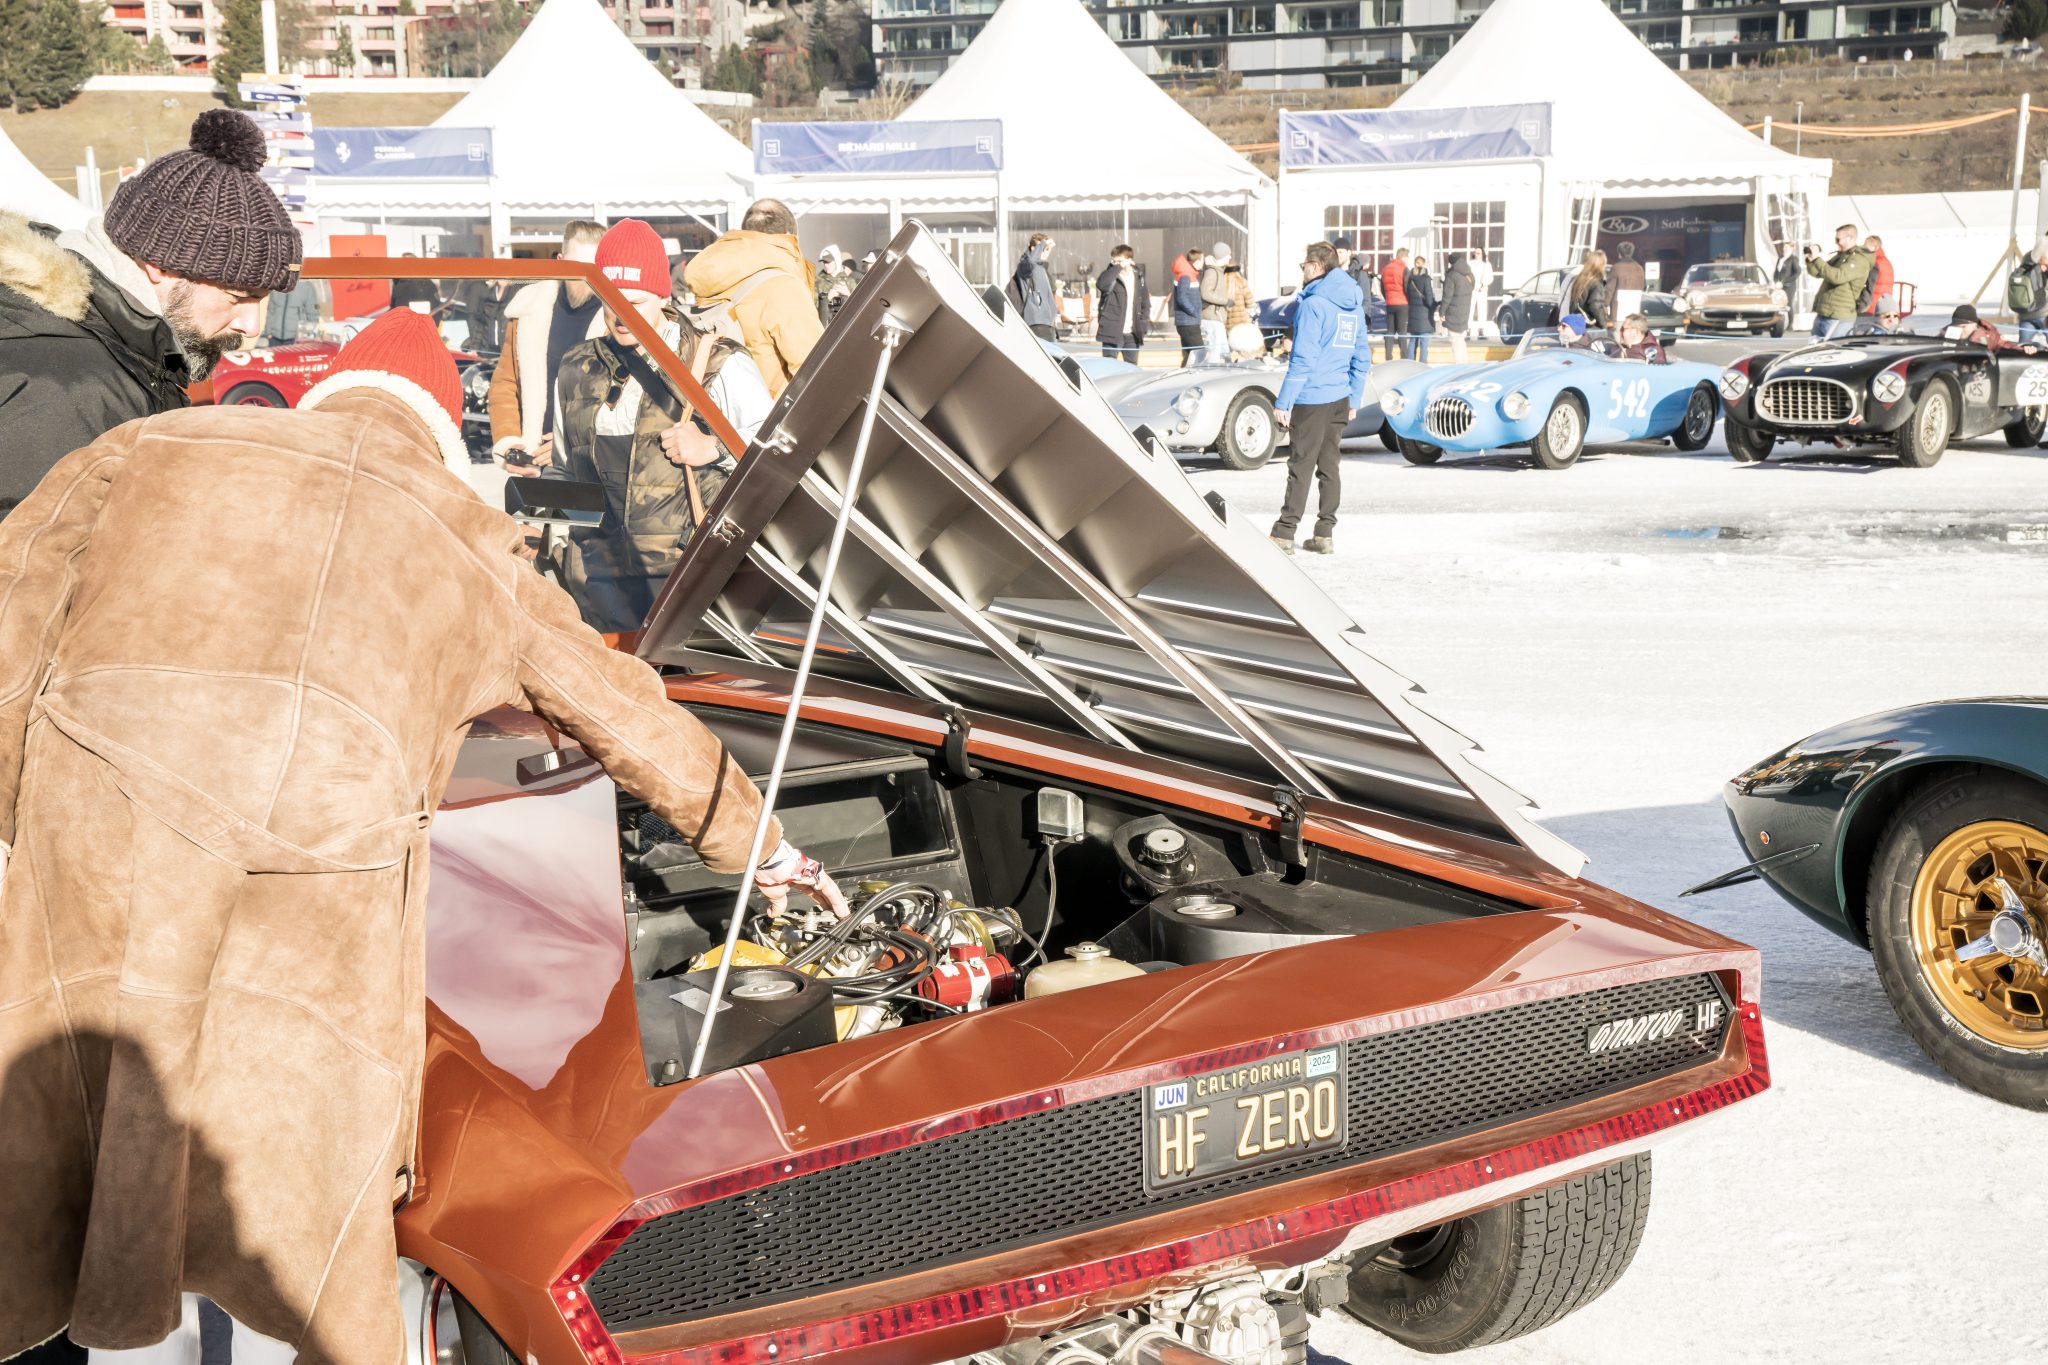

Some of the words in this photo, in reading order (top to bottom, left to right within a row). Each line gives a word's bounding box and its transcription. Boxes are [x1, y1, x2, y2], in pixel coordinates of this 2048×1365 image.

[838, 142, 885, 152] RICHARD
[885, 142, 917, 151] MILLE
[1608, 217, 1635, 232] RM
[1341, 320, 1353, 331] THE
[1340, 331, 1353, 341] ICE
[1607, 378, 1650, 419] 542
[1697, 1000, 1722, 1031] HF
[1312, 1054, 1331, 1067] 2022
[1196, 1058, 1301, 1097] CALIFORNIA
[1158, 1086, 1185, 1107] JUN
[1159, 1106, 1210, 1177] HF
[1235, 1078, 1337, 1159] ZERO
